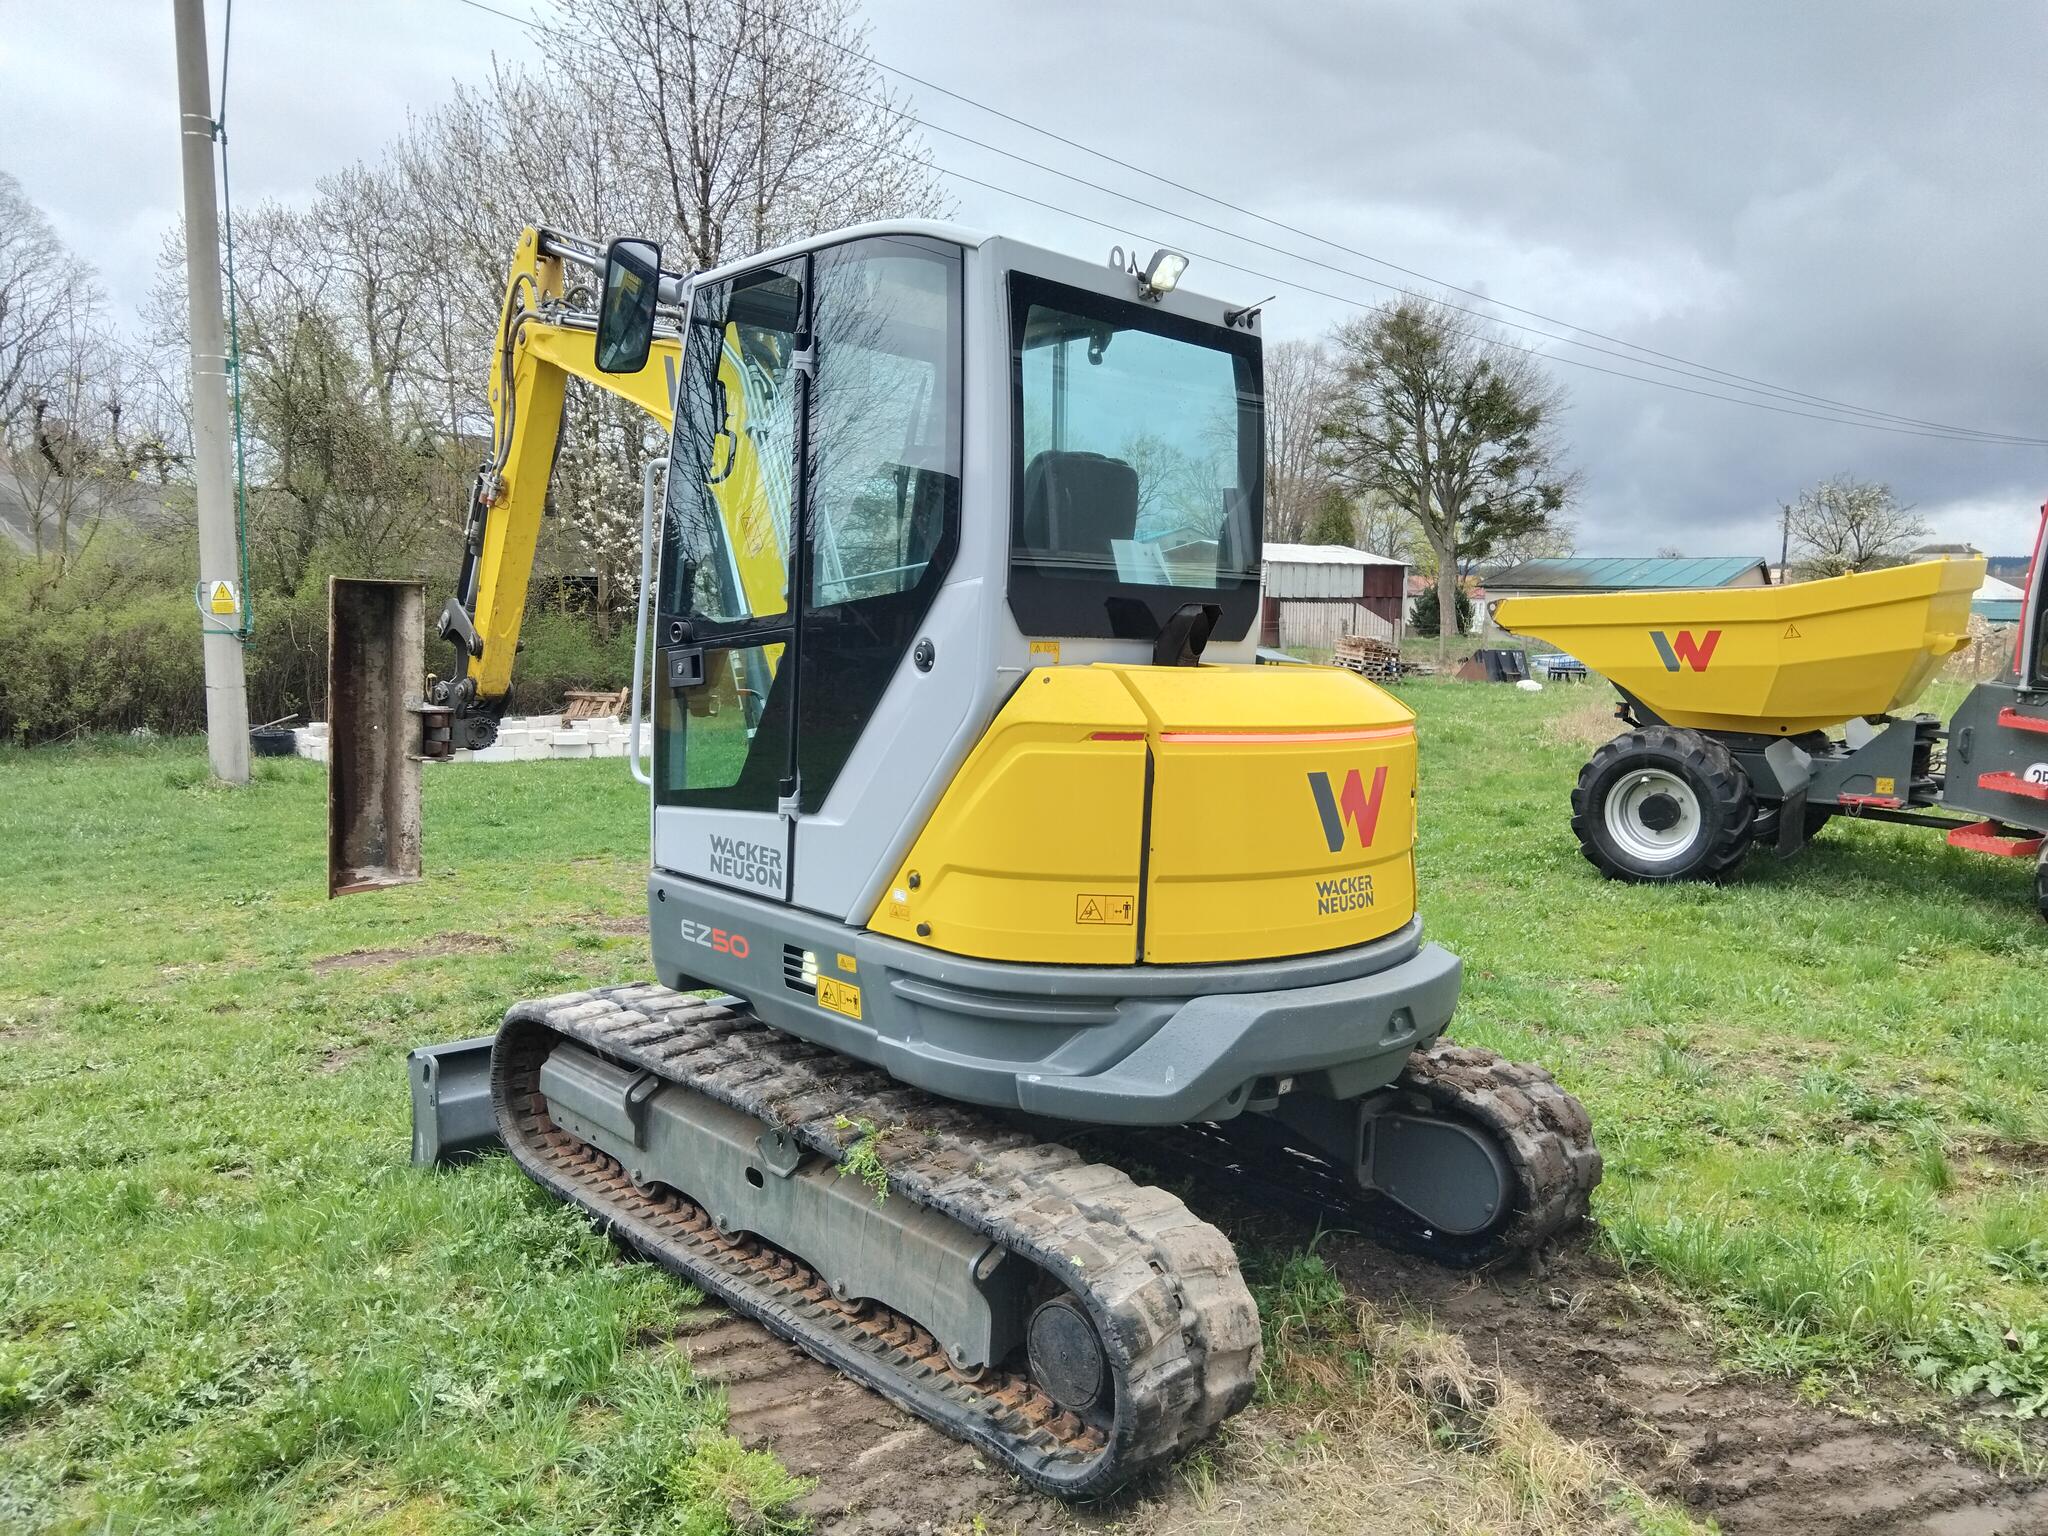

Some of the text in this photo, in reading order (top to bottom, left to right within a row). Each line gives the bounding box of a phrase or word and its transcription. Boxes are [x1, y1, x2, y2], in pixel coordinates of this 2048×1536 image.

[1307, 766, 1388, 853] W
[709, 833, 783, 870] WACKER
[710, 853, 783, 890] NEUSON
[1315, 874, 1374, 898] WACKER
[1317, 890, 1375, 916] NEUSON
[680, 918, 750, 960] EZ50
